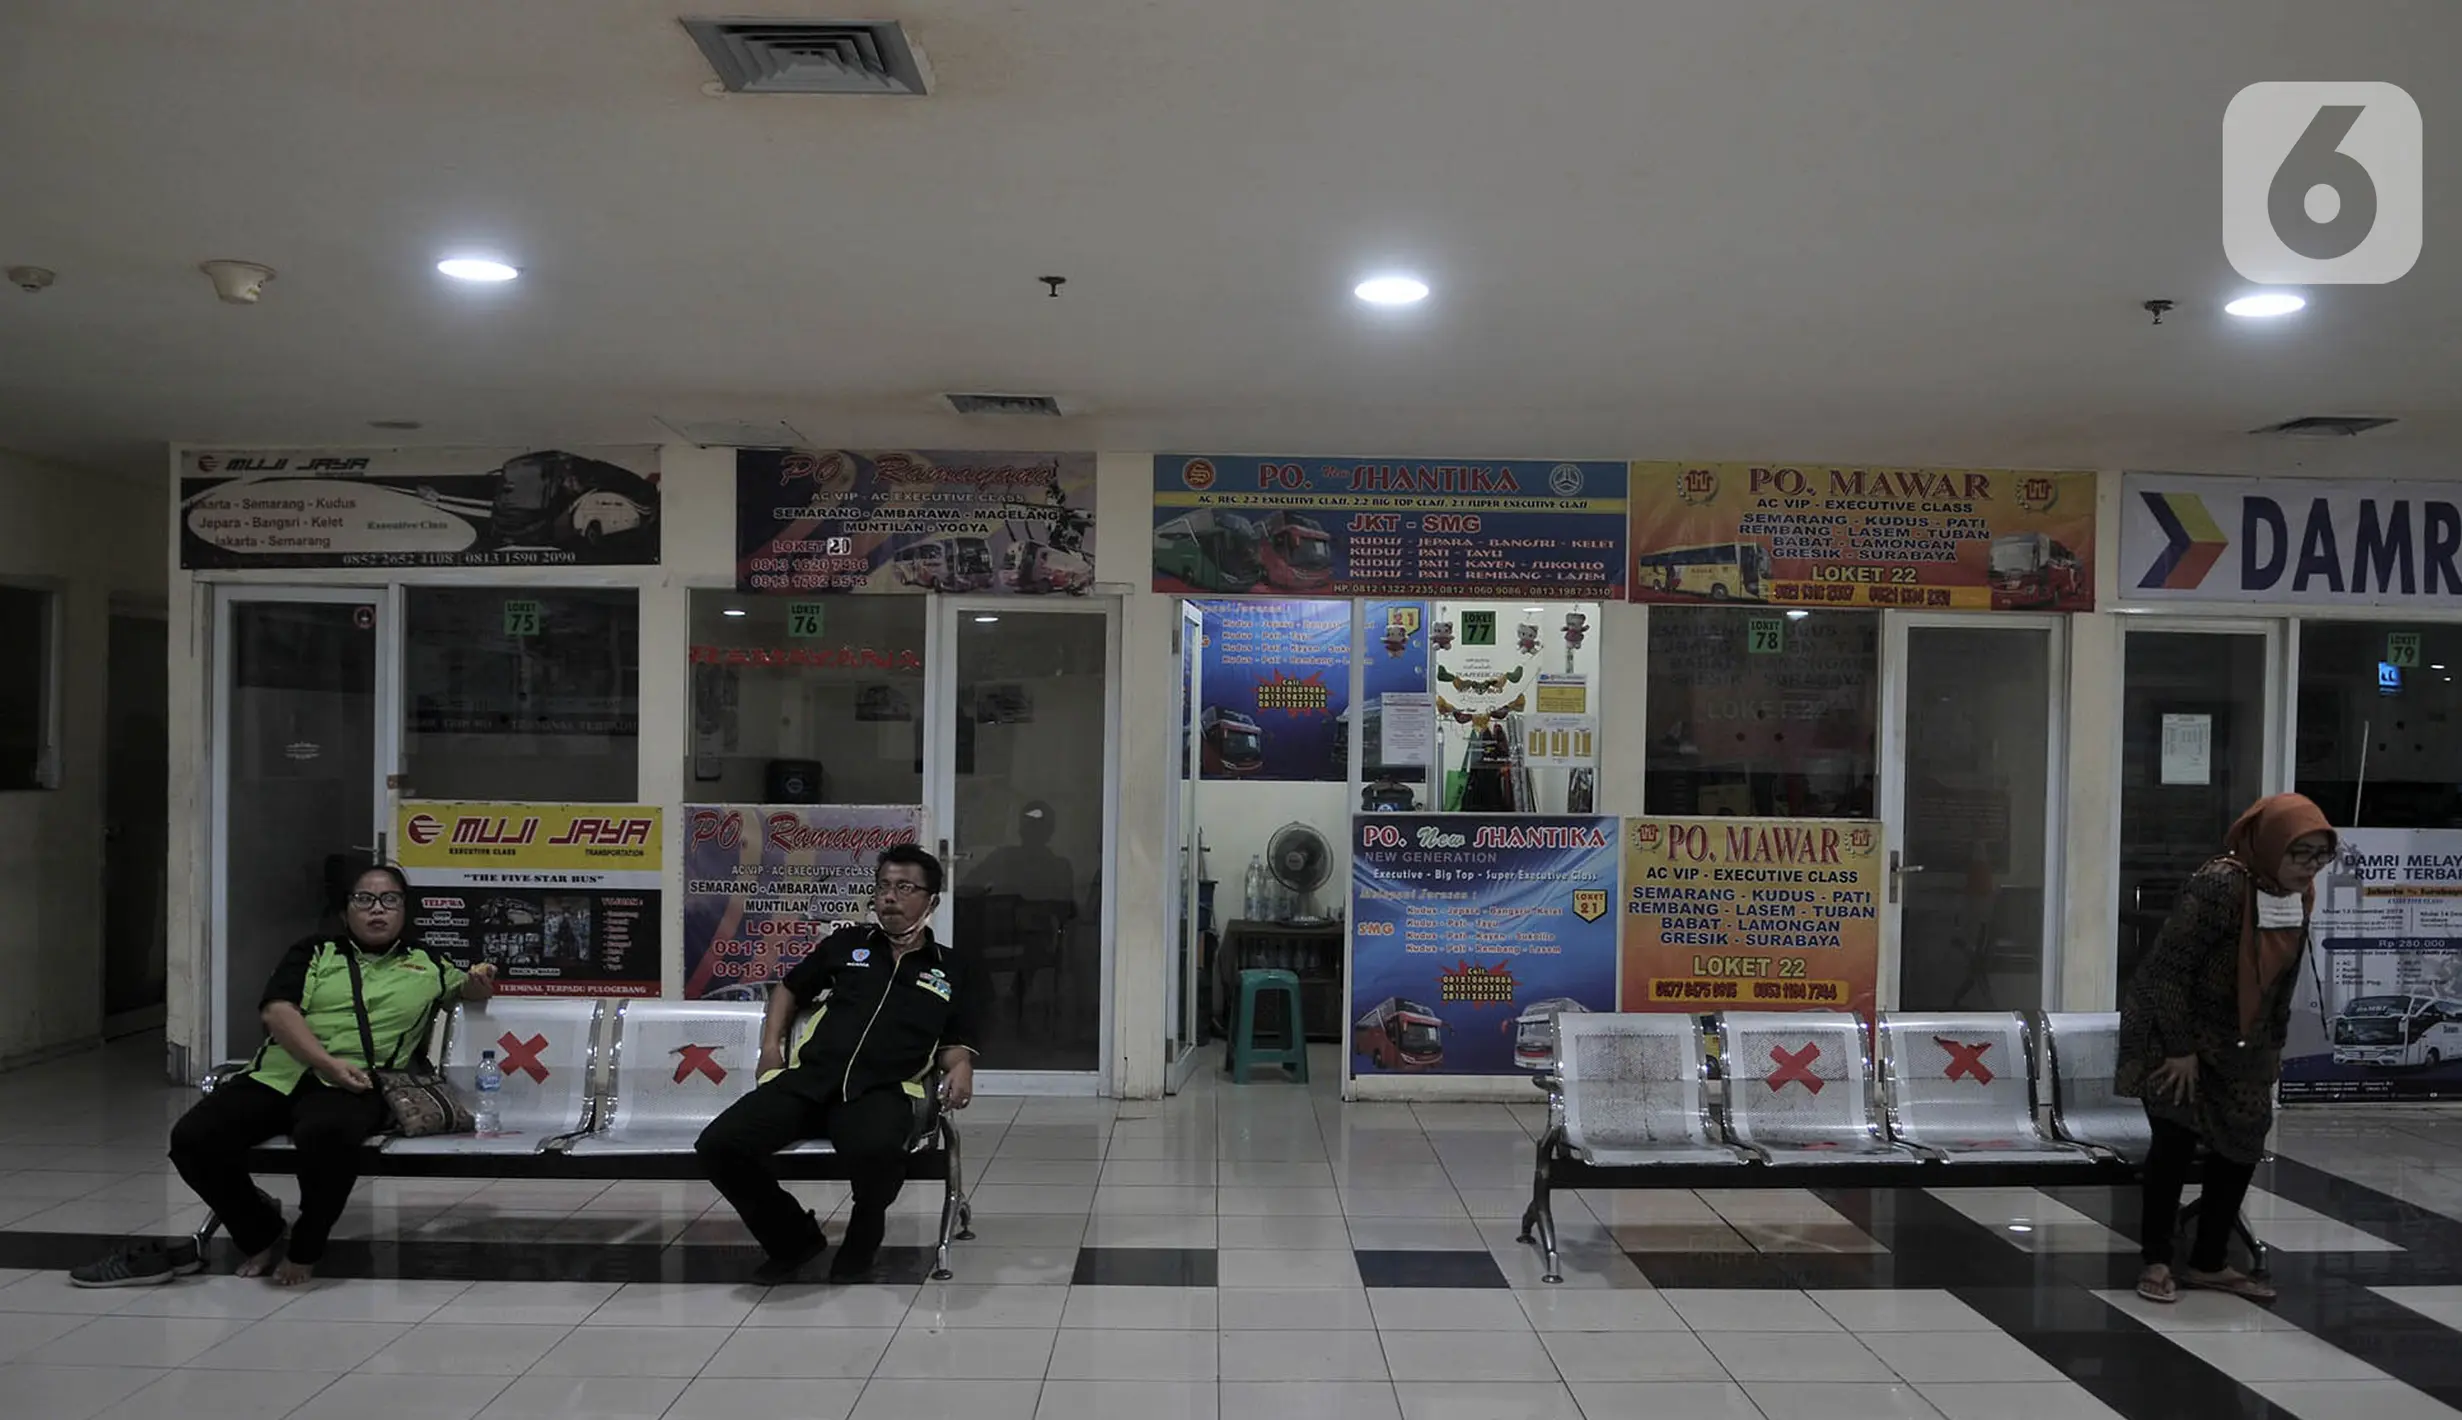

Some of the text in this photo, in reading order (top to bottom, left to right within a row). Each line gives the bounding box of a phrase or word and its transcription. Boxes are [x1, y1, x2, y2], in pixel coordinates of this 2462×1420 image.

[1258, 462, 1521, 494] PO. SHANTIKA
[1749, 468, 1993, 501] PO. MAWAR
[242, 498, 356, 512] Semarang Kudus
[811, 492, 1025, 504] AC VIP AC EXECUTIVE CLASS
[1262, 497, 1556, 509] EXECUTIVE EXECUTIVE
[1756, 499, 1973, 513] AC VIP EXECUTIVE CLASS
[773, 507, 1059, 521] SEMARANG AMBARAWA MAGELANG
[1743, 513, 1986, 529] SEMARANG KUDUS PATI
[199, 516, 344, 530] Jepara Bangsri Kelet
[844, 521, 990, 533] MUNTILAN YOGYA
[1347, 514, 1482, 533] JKT SMG
[1738, 524, 1990, 540] REMBANG LASEM TUBAN
[268, 535, 331, 549] Semarang
[772, 539, 826, 553] LOKET
[1349, 536, 1402, 546] KUDUS
[1417, 537, 1473, 548] JEPARA
[1772, 536, 1956, 551] BABAT LAMONGAN
[466, 553, 499, 564] 0813
[1349, 547, 1402, 557] KUDUS
[1417, 547, 1450, 558] PATI
[1771, 547, 1958, 562] GRESIK SURABAYA
[1349, 558, 1402, 568] KUDUS
[1417, 558, 1450, 568] PATI
[1465, 558, 1516, 569] KAYEN
[1349, 568, 1606, 582] KUDUS PATI REMBANG LASEM
[1811, 565, 1918, 584] LOKET 22
[1353, 584, 1465, 594] 0812 1322 0812
[791, 604, 820, 614] LOKET
[510, 614, 535, 632] 75
[794, 616, 818, 634] 76
[1464, 612, 1492, 624] LOKET
[1751, 620, 1780, 630] LOKET
[1467, 625, 1489, 642] 77
[1756, 632, 1779, 649] 78
[2391, 646, 2413, 662] 79
[547, 818, 653, 846] JAYA
[690, 810, 917, 863] PO Ramayana
[1363, 824, 1608, 849] PO. New SHANTIKA
[1667, 823, 1844, 866] PO. MAWAR
[448, 848, 490, 856] EXECUTIVE
[493, 848, 516, 856] CLASS
[1365, 851, 1497, 864] NEW GENERATION
[2345, 854, 2399, 866] DAMRI
[731, 866, 747, 876] AC
[771, 867, 786, 876] AC
[788, 866, 843, 877] EXECUTIVE
[845, 867, 876, 877] CLASS
[1374, 868, 1598, 882] Executive Big Top Super Executive Class
[1646, 868, 1859, 884] AC VIP EXECUTIVE CLASS
[2355, 868, 2397, 880] RUTE
[501, 874, 531, 883] FIVE
[534, 874, 568, 884] STAR
[690, 881, 838, 895] SEMARANG AMBARAWA
[1576, 893, 1604, 901] LOKET
[1633, 888, 1871, 904] SEMARANG KUDUS PATI
[745, 900, 860, 914] MUNTILAN YOGYA
[1406, 906, 1438, 916] Kudus
[1580, 903, 1599, 915] 21
[1629, 902, 1876, 919] REMBANG LASEM TUBAN
[746, 921, 821, 936] LOKET
[1358, 921, 1396, 936] SMG
[1406, 919, 1438, 928] Kudus
[1662, 918, 1841, 932] BABAT LAMONGAN
[1406, 931, 1438, 941] Kudus
[1660, 932, 1841, 947] GRESIK SURABAYA
[713, 939, 767, 957] 0813
[1406, 944, 1438, 953] Kudus
[713, 962, 767, 978] 0813
[1692, 955, 1806, 978] LOKET 22
[498, 983, 646, 994] TERMINAL TERPADU PULOGEBANG
